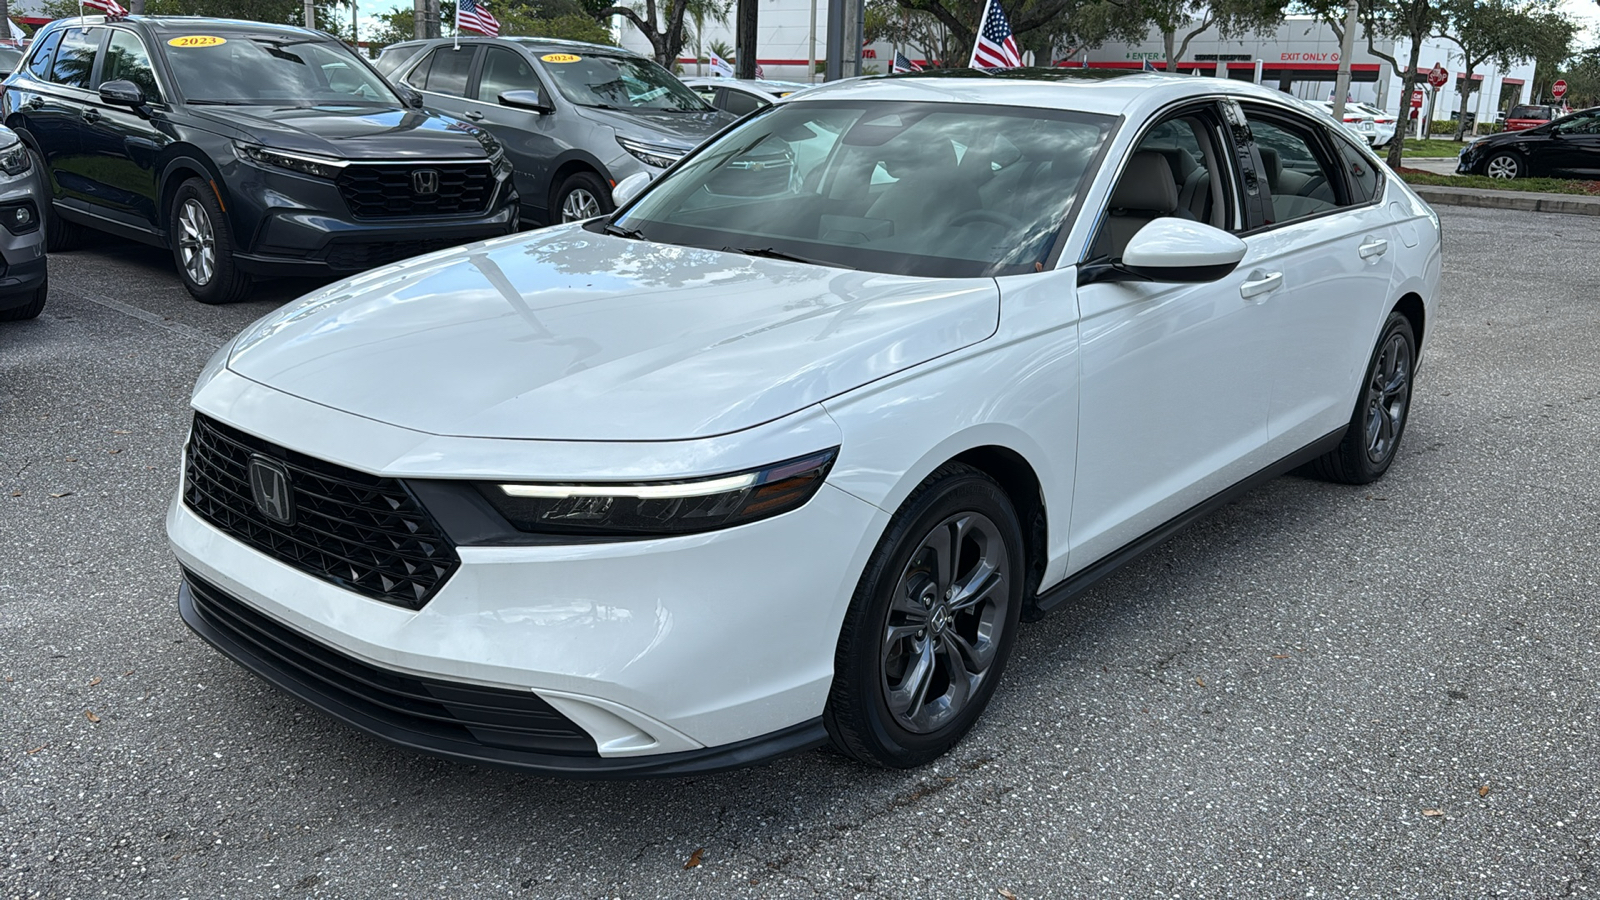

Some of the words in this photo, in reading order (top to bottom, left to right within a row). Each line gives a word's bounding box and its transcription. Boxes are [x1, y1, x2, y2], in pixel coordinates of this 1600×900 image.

[180, 37, 217, 46] 2023
[1132, 52, 1159, 60] ENTER
[1281, 53, 1301, 61] EXIT
[1302, 52, 1328, 61] ONLY
[1553, 84, 1567, 92] STOP
